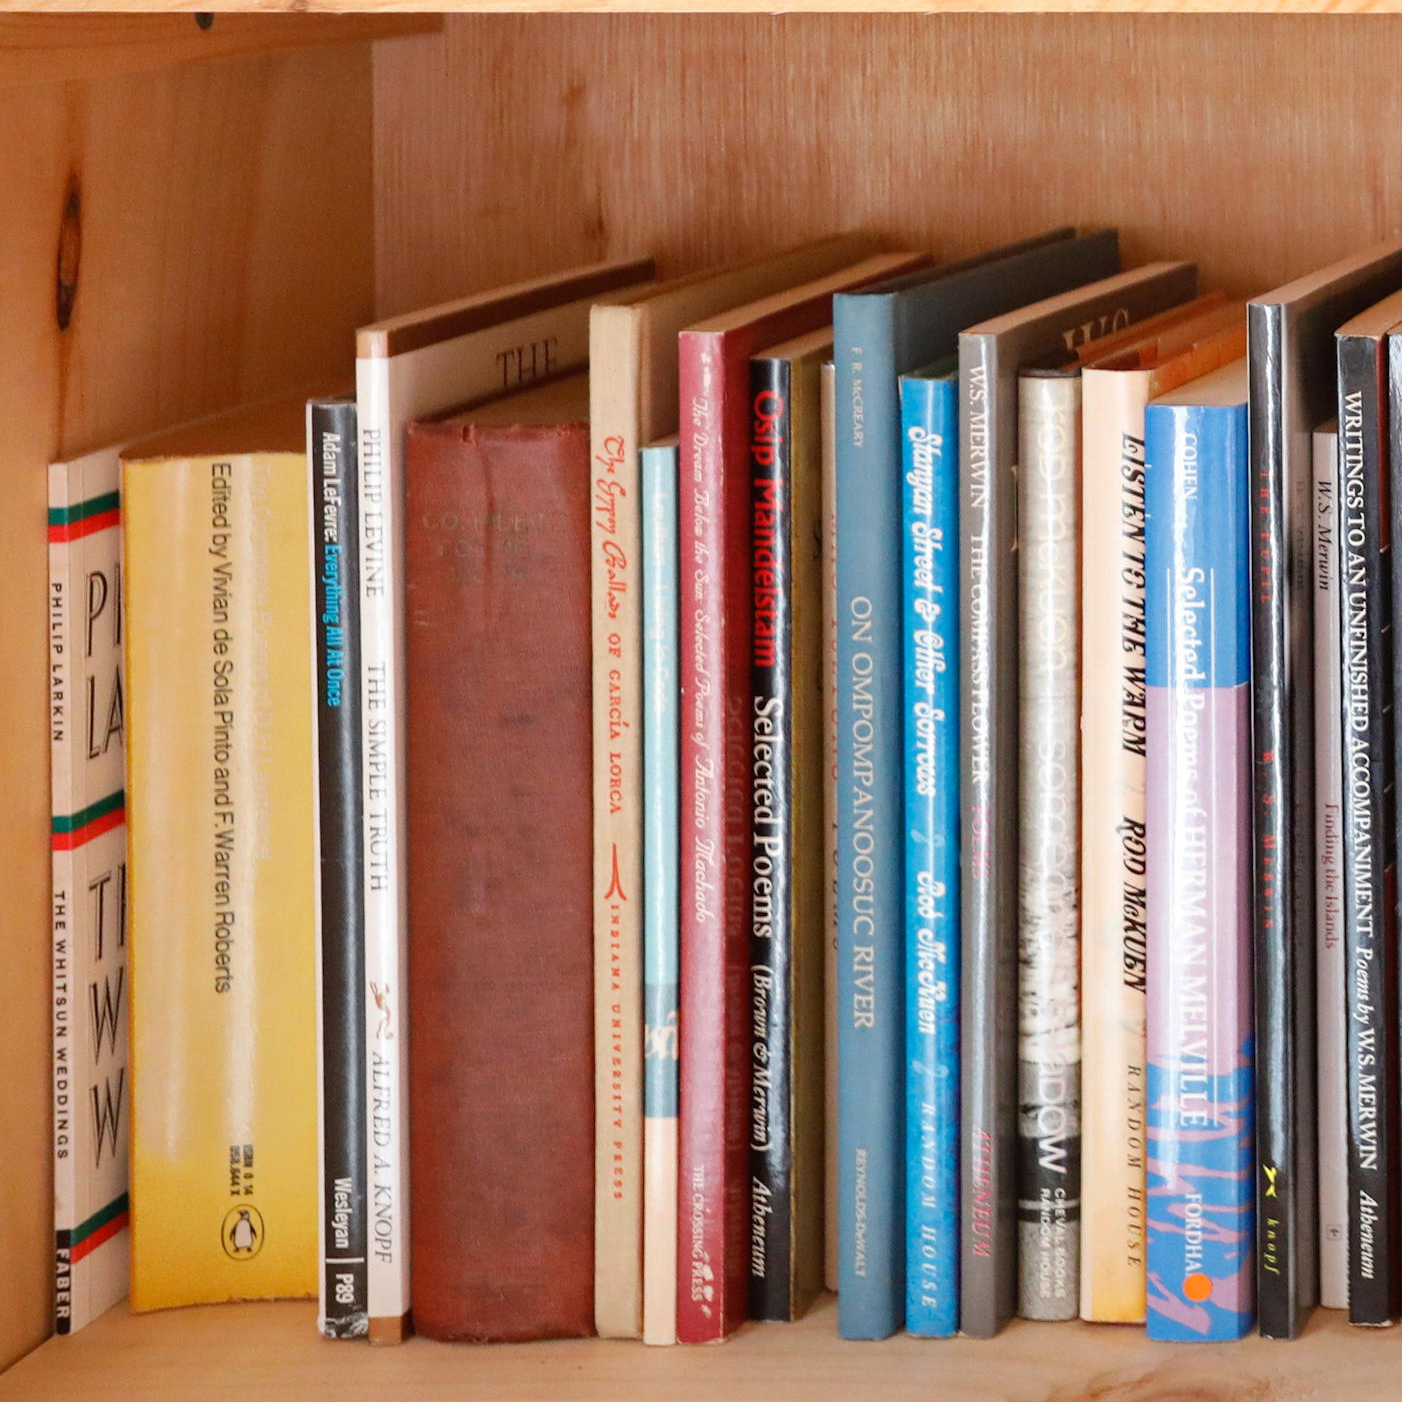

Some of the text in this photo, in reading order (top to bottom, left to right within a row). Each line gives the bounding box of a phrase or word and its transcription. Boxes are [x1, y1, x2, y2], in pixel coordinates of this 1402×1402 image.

[322, 433, 340, 475] Adam
[52, 583, 63, 740] PHILIP LARKIN
[851, 597, 874, 1028] ON OMPOMPANOOSUC RIVER
[55, 891, 68, 1158] THE WHITSUN WEDDINGS
[56, 1248, 70, 1318] FABER
[331, 1178, 354, 1304] Wesleyan P89
